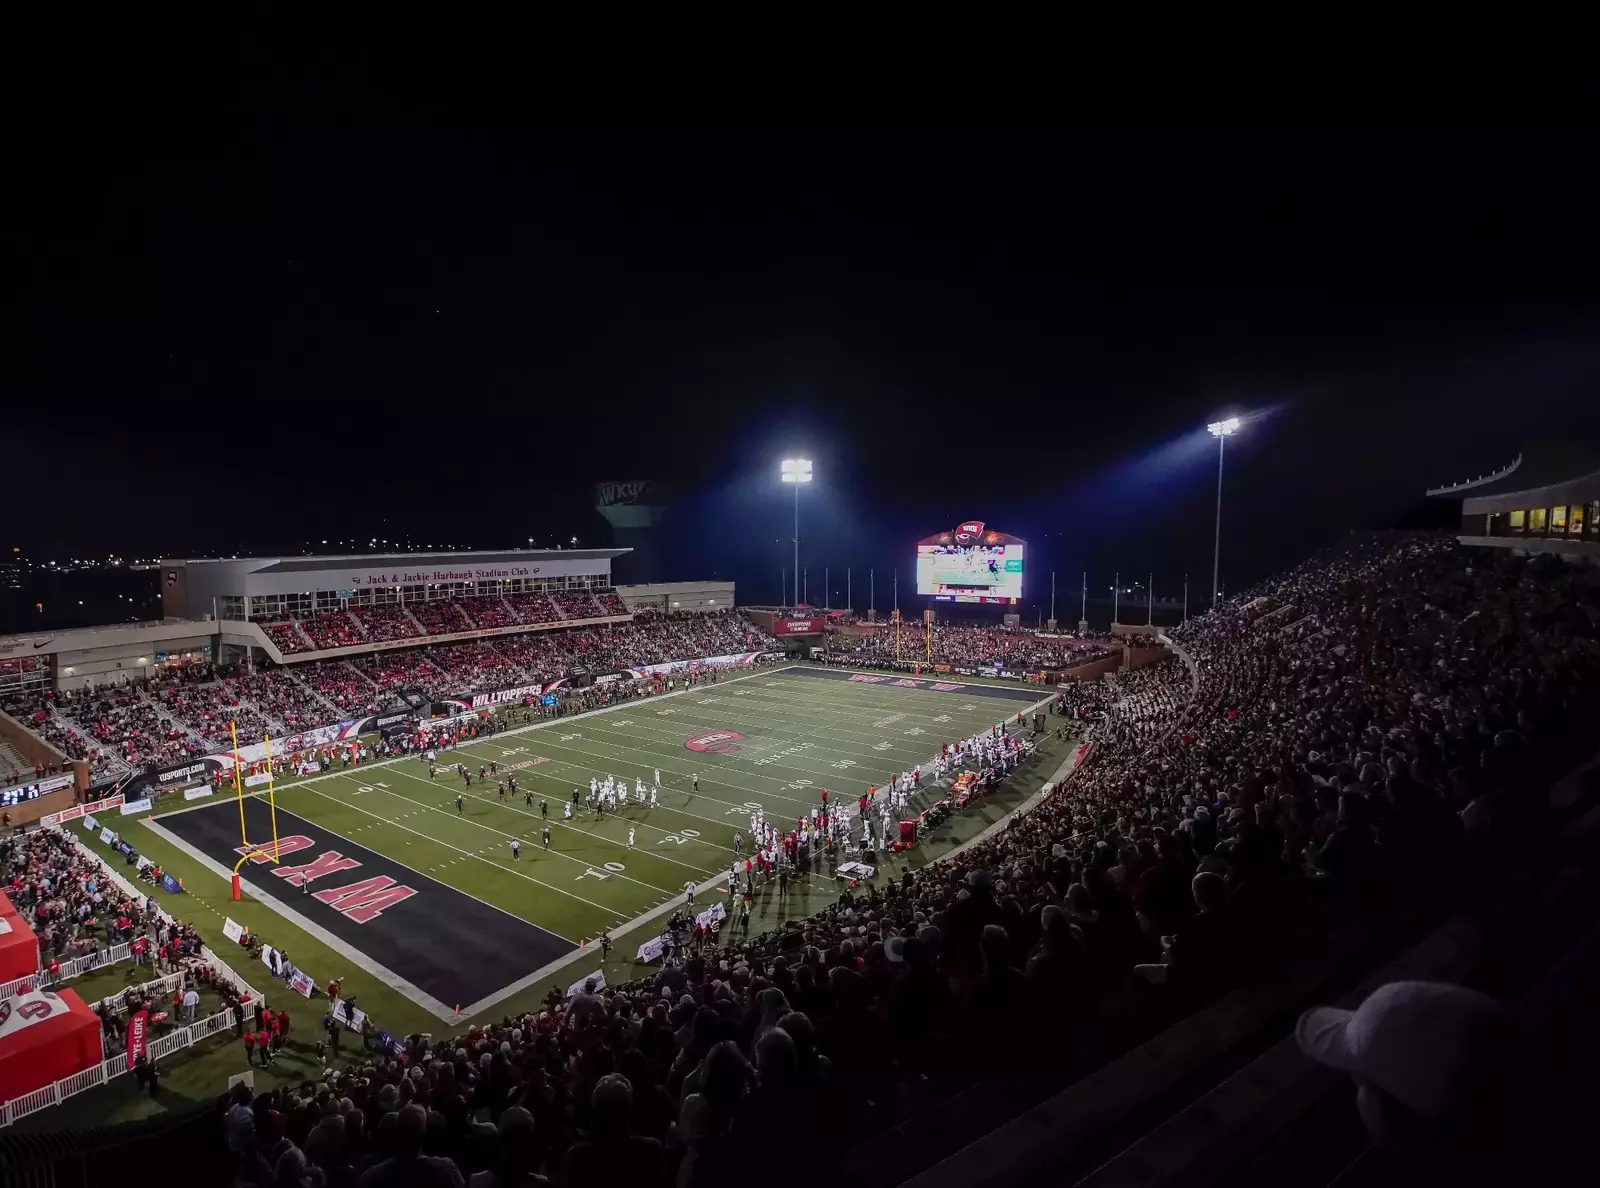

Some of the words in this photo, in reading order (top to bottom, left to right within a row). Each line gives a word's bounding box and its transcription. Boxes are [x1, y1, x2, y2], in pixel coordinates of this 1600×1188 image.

[366, 575, 388, 584] Jack
[391, 574, 399, 583] &
[403, 573, 430, 582] Jackie
[433, 571, 473, 581] Harbaugh
[476, 569, 509, 578] Stadium
[511, 568, 529, 576] Club
[472, 684, 543, 708] HILLTOPPERS
[358, 782, 392, 793] 10
[788, 779, 814, 790] 40
[731, 801, 763, 815] 30
[666, 829, 701, 845] 20
[584, 862, 626, 881] 10
[233, 835, 420, 925] WKU
